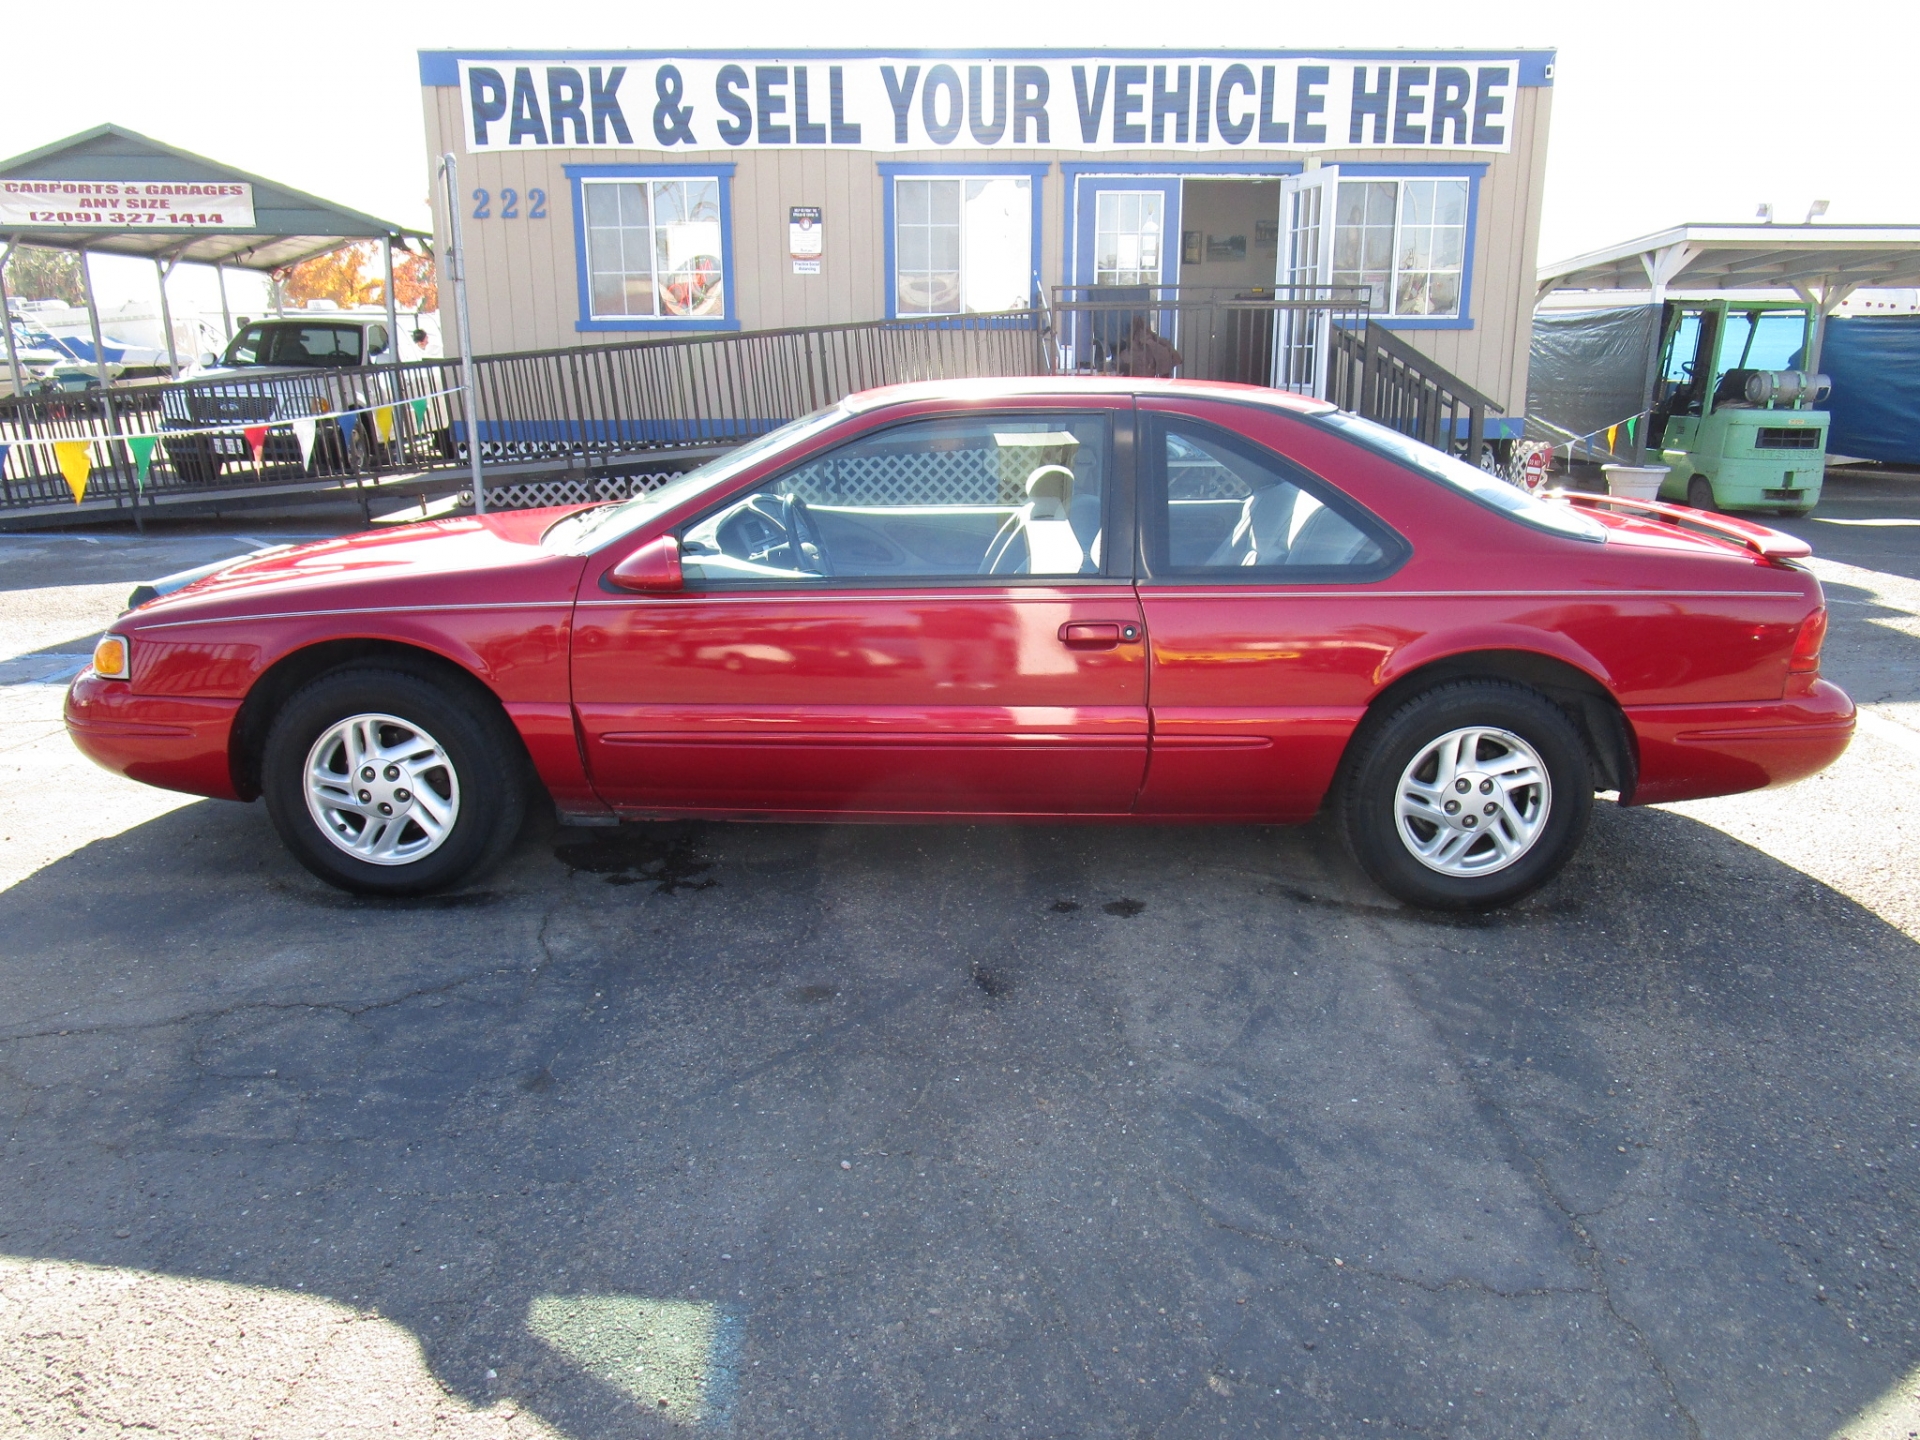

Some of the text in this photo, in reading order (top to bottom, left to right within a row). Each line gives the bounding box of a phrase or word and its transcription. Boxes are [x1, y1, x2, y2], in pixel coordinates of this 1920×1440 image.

[468, 63, 1510, 146] PARK & SELL YOUR VEHICLE HERE
[5, 183, 244, 196] CARPORTS & GARAGES
[79, 198, 171, 209] ANY SIZE
[472, 188, 547, 219] 222
[30, 212, 224, 224] (209) 327-1414
